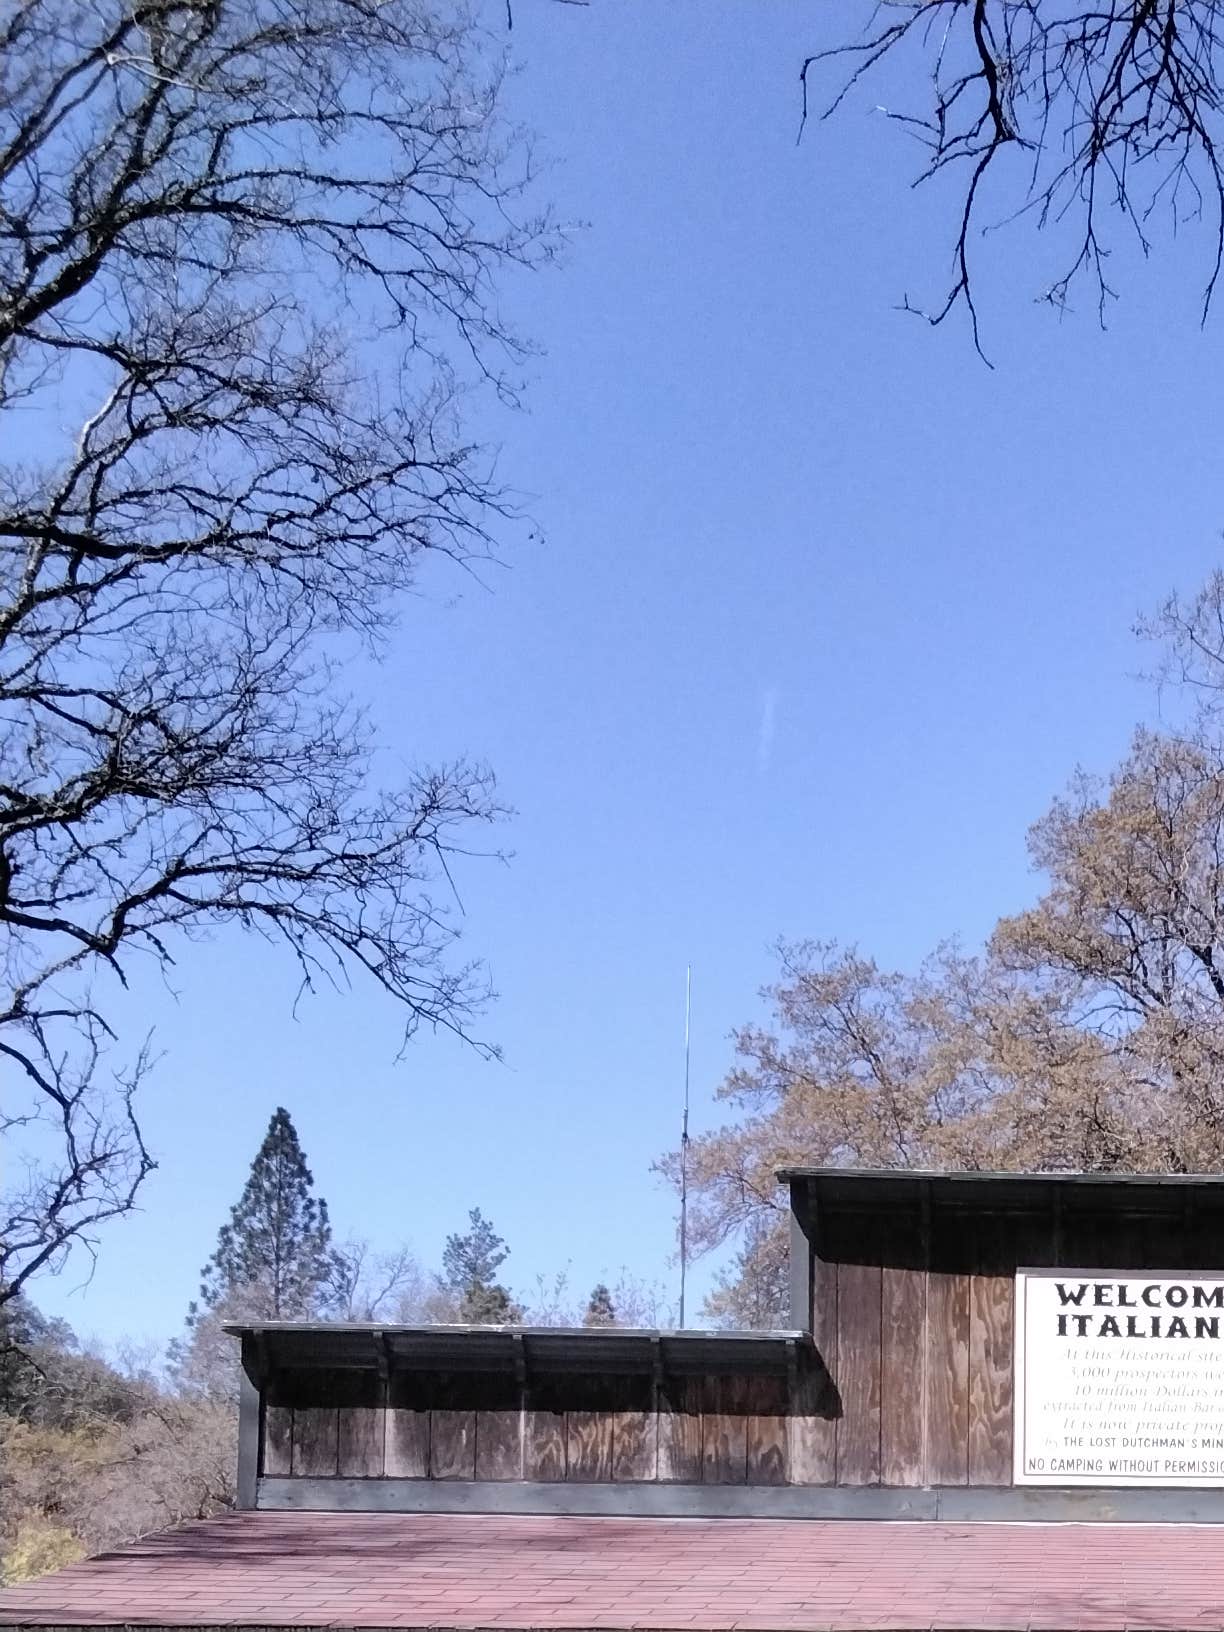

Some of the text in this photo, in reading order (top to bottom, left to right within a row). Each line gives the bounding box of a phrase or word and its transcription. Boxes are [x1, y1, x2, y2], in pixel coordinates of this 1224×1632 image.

[1056, 1314, 1221, 1338] ITALIAN
[1063, 1436, 1084, 1448] THE
[1089, 1437, 1117, 1448] LOST
[1028, 1457, 1046, 1472] NO
[1050, 1458, 1104, 1473] CAMPING
[1108, 1458, 1160, 1474] WITHOUT
